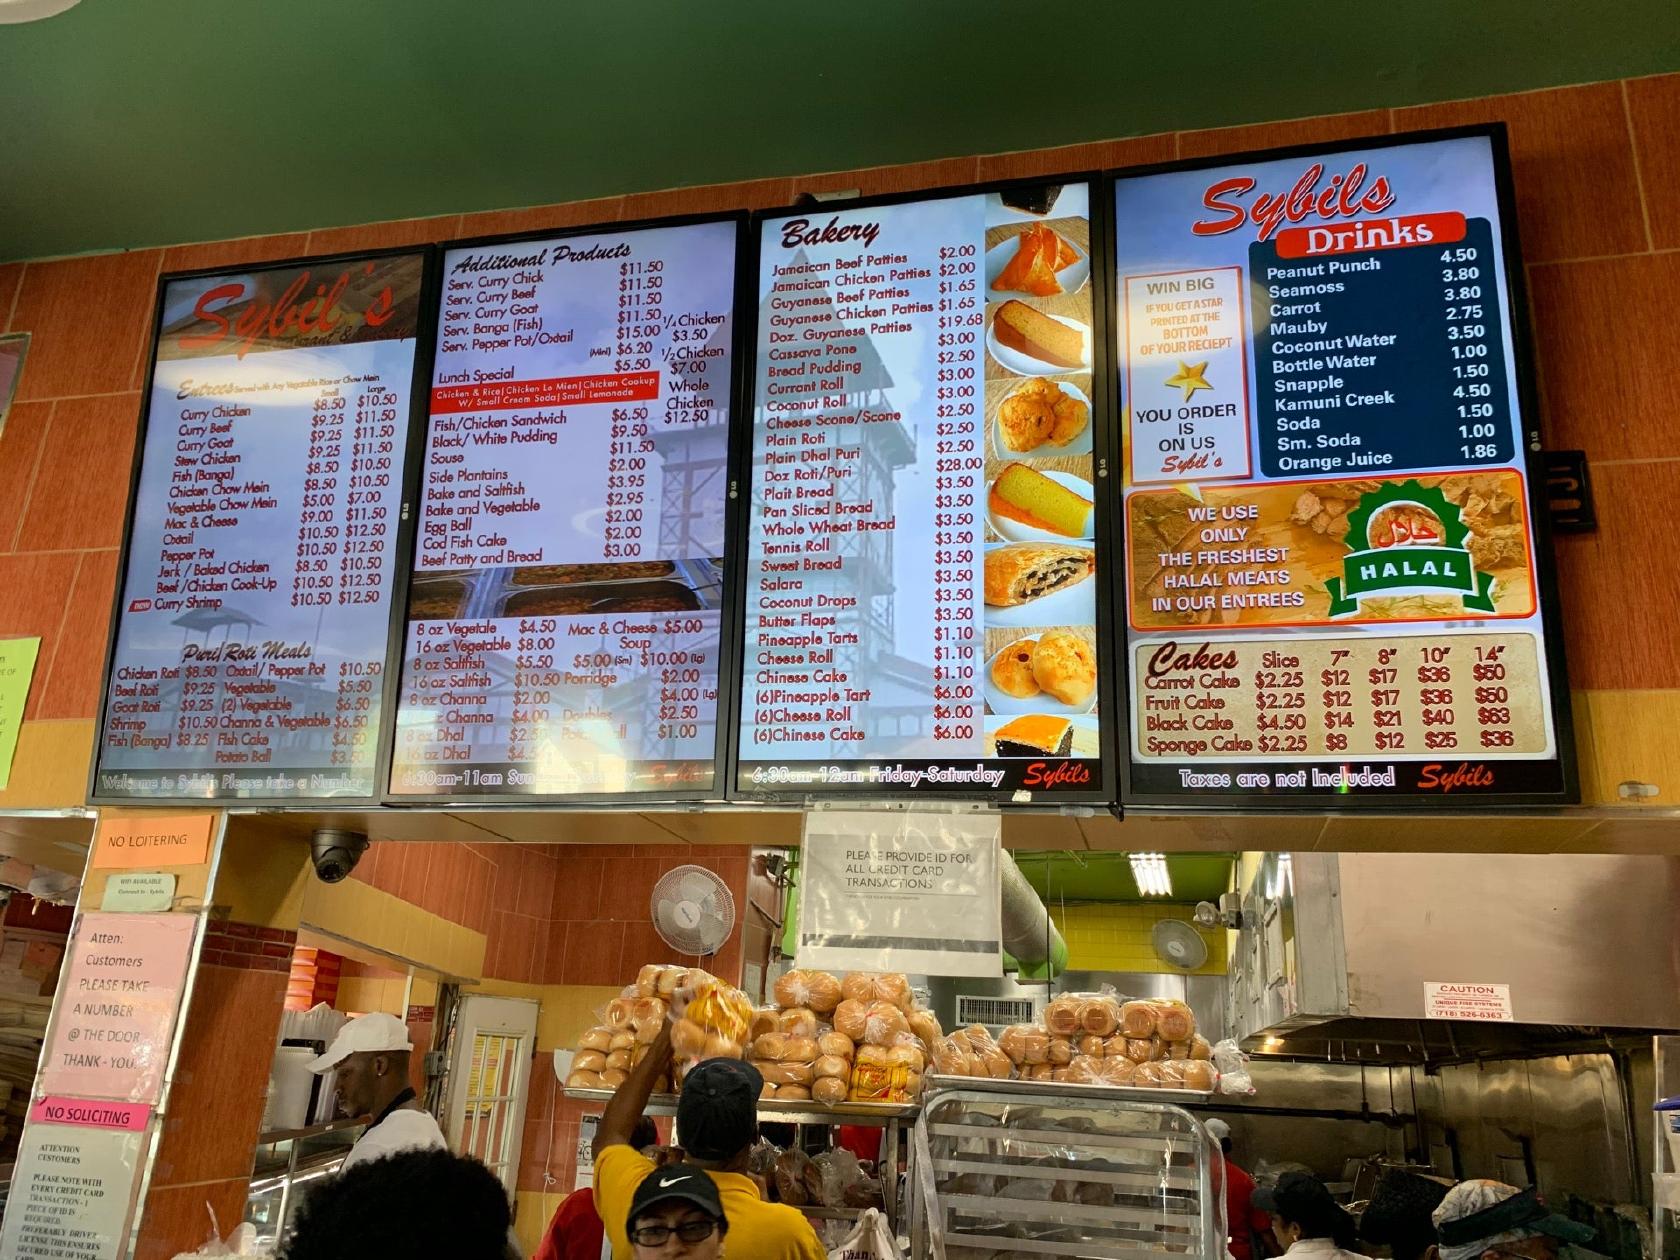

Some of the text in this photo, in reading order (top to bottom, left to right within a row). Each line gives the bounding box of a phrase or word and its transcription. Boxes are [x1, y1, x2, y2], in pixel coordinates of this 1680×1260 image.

[1191, 163, 1395, 241] Sybils
[781, 216, 880, 248] Bakery
[1306, 219, 1434, 254] Drinks
[450, 243, 631, 275] Additional Products
[772, 245, 976, 277] Jamaican Beef Patties $2.00
[1267, 248, 1477, 280] Peanut Punch 4.50
[448, 261, 663, 291] Serv. Curry Chick $11.50
[1269, 267, 1479, 298] Seamoss 3.80
[1146, 277, 1214, 295] WIN BIG
[178, 263, 395, 361] Sybil's
[1146, 298, 1222, 313] IF YOU GET A STAR
[770, 313, 983, 344] Doz. Guyanese Patties $19.68
[1272, 324, 1485, 354] Coconut Water 3.50
[438, 358, 650, 384] Lunch Special $5.50
[180, 394, 397, 421] Curry Chicken $8.50 $10.50
[1136, 404, 1236, 423] YOU ORDER
[434, 408, 648, 432] Fish/Chicken Sandwich $6.50
[1179, 423, 1194, 435] IS
[765, 440, 974, 465] Plain Dhal Puri $2.50
[1159, 436, 1214, 452] ON US
[428, 475, 644, 500] Bake and Saltfish $3.95
[1188, 505, 1258, 522] WE USE
[163, 524, 386, 545] Oxtail $10.50 $12.50
[1200, 527, 1247, 543] ONLY
[1158, 547, 1288, 566] THE FRESHEST
[1164, 570, 1290, 589] HALAL MEATS
[1361, 561, 1457, 580] HALAL
[154, 590, 379, 612] Curry Shrimp $10.50 $12.50
[1152, 592, 1304, 611] IN OUR ENTREES
[567, 620, 702, 636] Mac & Cheese $5.00
[1148, 641, 1239, 677] Cakes
[1262, 651, 1299, 668] Slice
[118, 665, 217, 680] Chicken Roti $8.50
[268, 665, 306, 679] Pepper
[308, 663, 326, 676] Pot
[339, 662, 382, 676] $10.50
[1145, 663, 1505, 690] Carrot Cake $2.25 $12 $17 $36 $50
[830, 726, 865, 741] Cake
[933, 725, 973, 740] $6.00
[869, 764, 1005, 787] Friday-Saturday
[1024, 761, 1091, 788] Sybils
[1179, 762, 1495, 793] Taxes are not Included Sybils
[109, 834, 187, 847] NO LOITERING
[846, 850, 973, 864] PLEAE PROVIDE ID FOR
[846, 865, 865, 873] ALL
[913, 866, 944, 876] CARD
[90, 933, 124, 945] Atten:
[86, 954, 143, 967] Customers
[80, 978, 150, 992] PLEASE TAKE
[1440, 985, 1494, 993] CAUTION
[73, 1003, 133, 1017] A NUMBER
[68, 1029, 140, 1042] @ THE DOOR
[63, 1054, 101, 1067] THANK
[45, 1107, 130, 1124] NO SOLICITING
[38, 1153, 81, 1164] CUSTOMERS
[41, 1145, 80, 1153] ATTENTION
[33, 1174, 102, 1187] PLEASE NOTE WITH
[32, 1184, 104, 1197] EVERY CREDIT CARD
